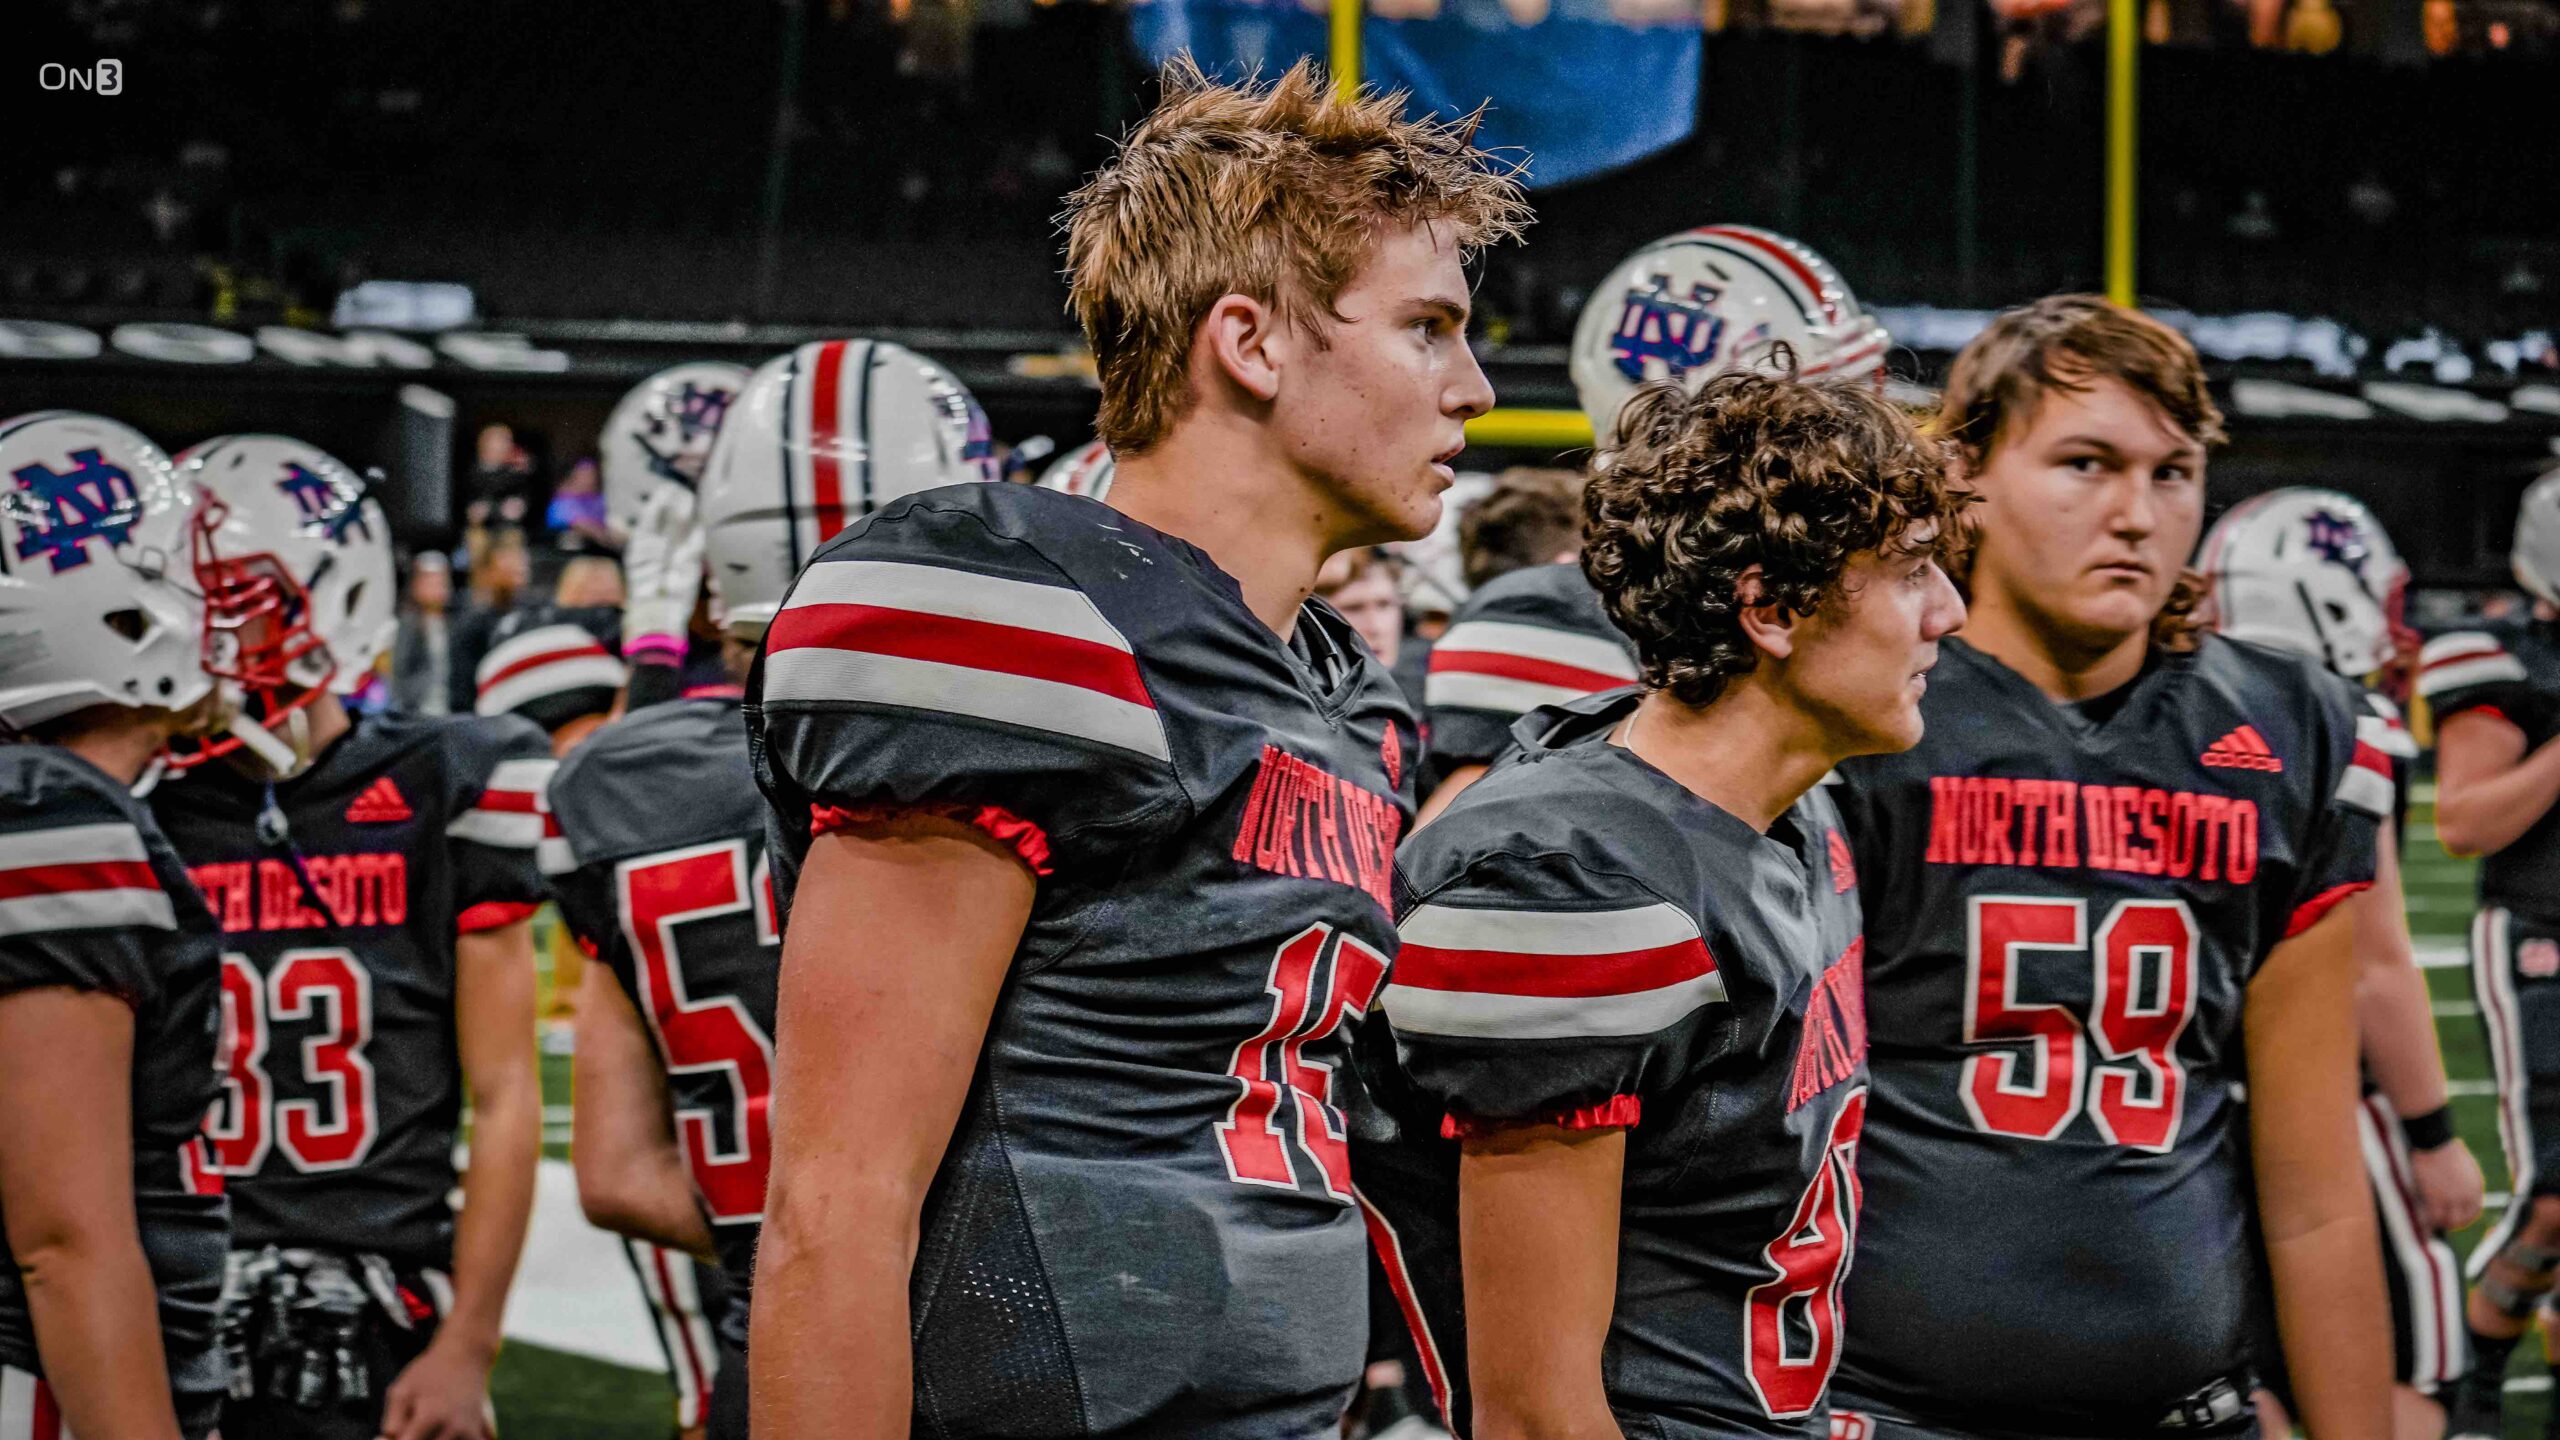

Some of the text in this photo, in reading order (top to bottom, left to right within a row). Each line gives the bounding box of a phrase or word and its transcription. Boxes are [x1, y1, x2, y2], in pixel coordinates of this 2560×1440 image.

[1926, 776, 2258, 884] NORTH DESOTO
[616, 838, 781, 1226] 5
[1958, 895, 2200, 1153] 59
[1744, 1086, 1867, 1420] 8
